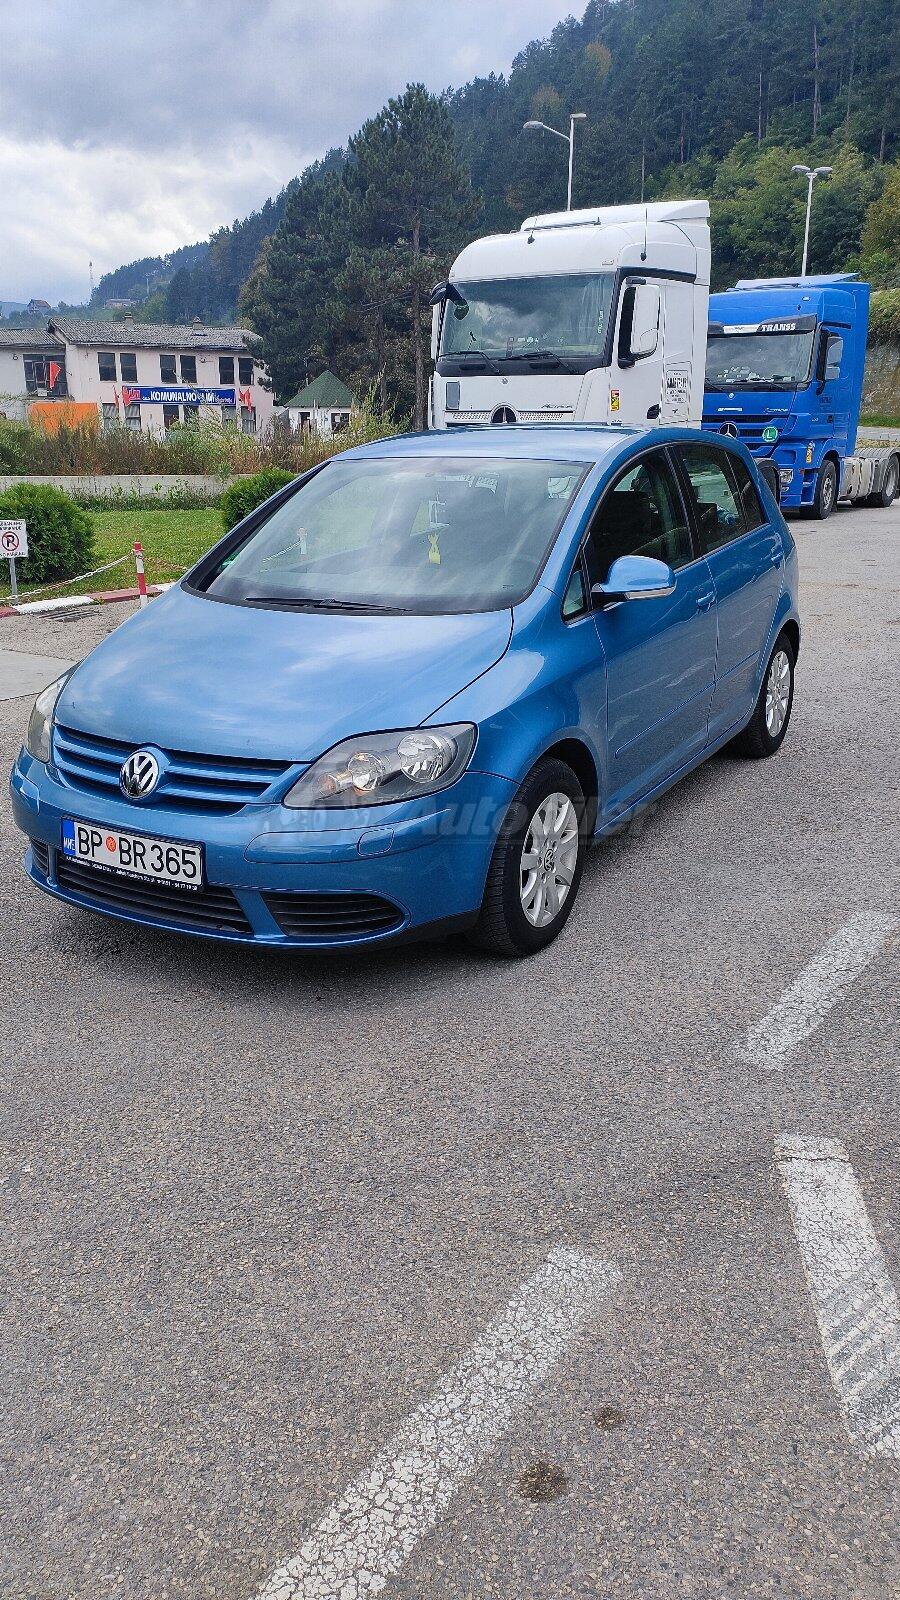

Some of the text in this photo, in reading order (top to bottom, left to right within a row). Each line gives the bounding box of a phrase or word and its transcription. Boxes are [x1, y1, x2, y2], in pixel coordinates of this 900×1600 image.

[150, 390, 197, 402] KOMUNALNO
[77, 826, 197, 879] BP BR365
